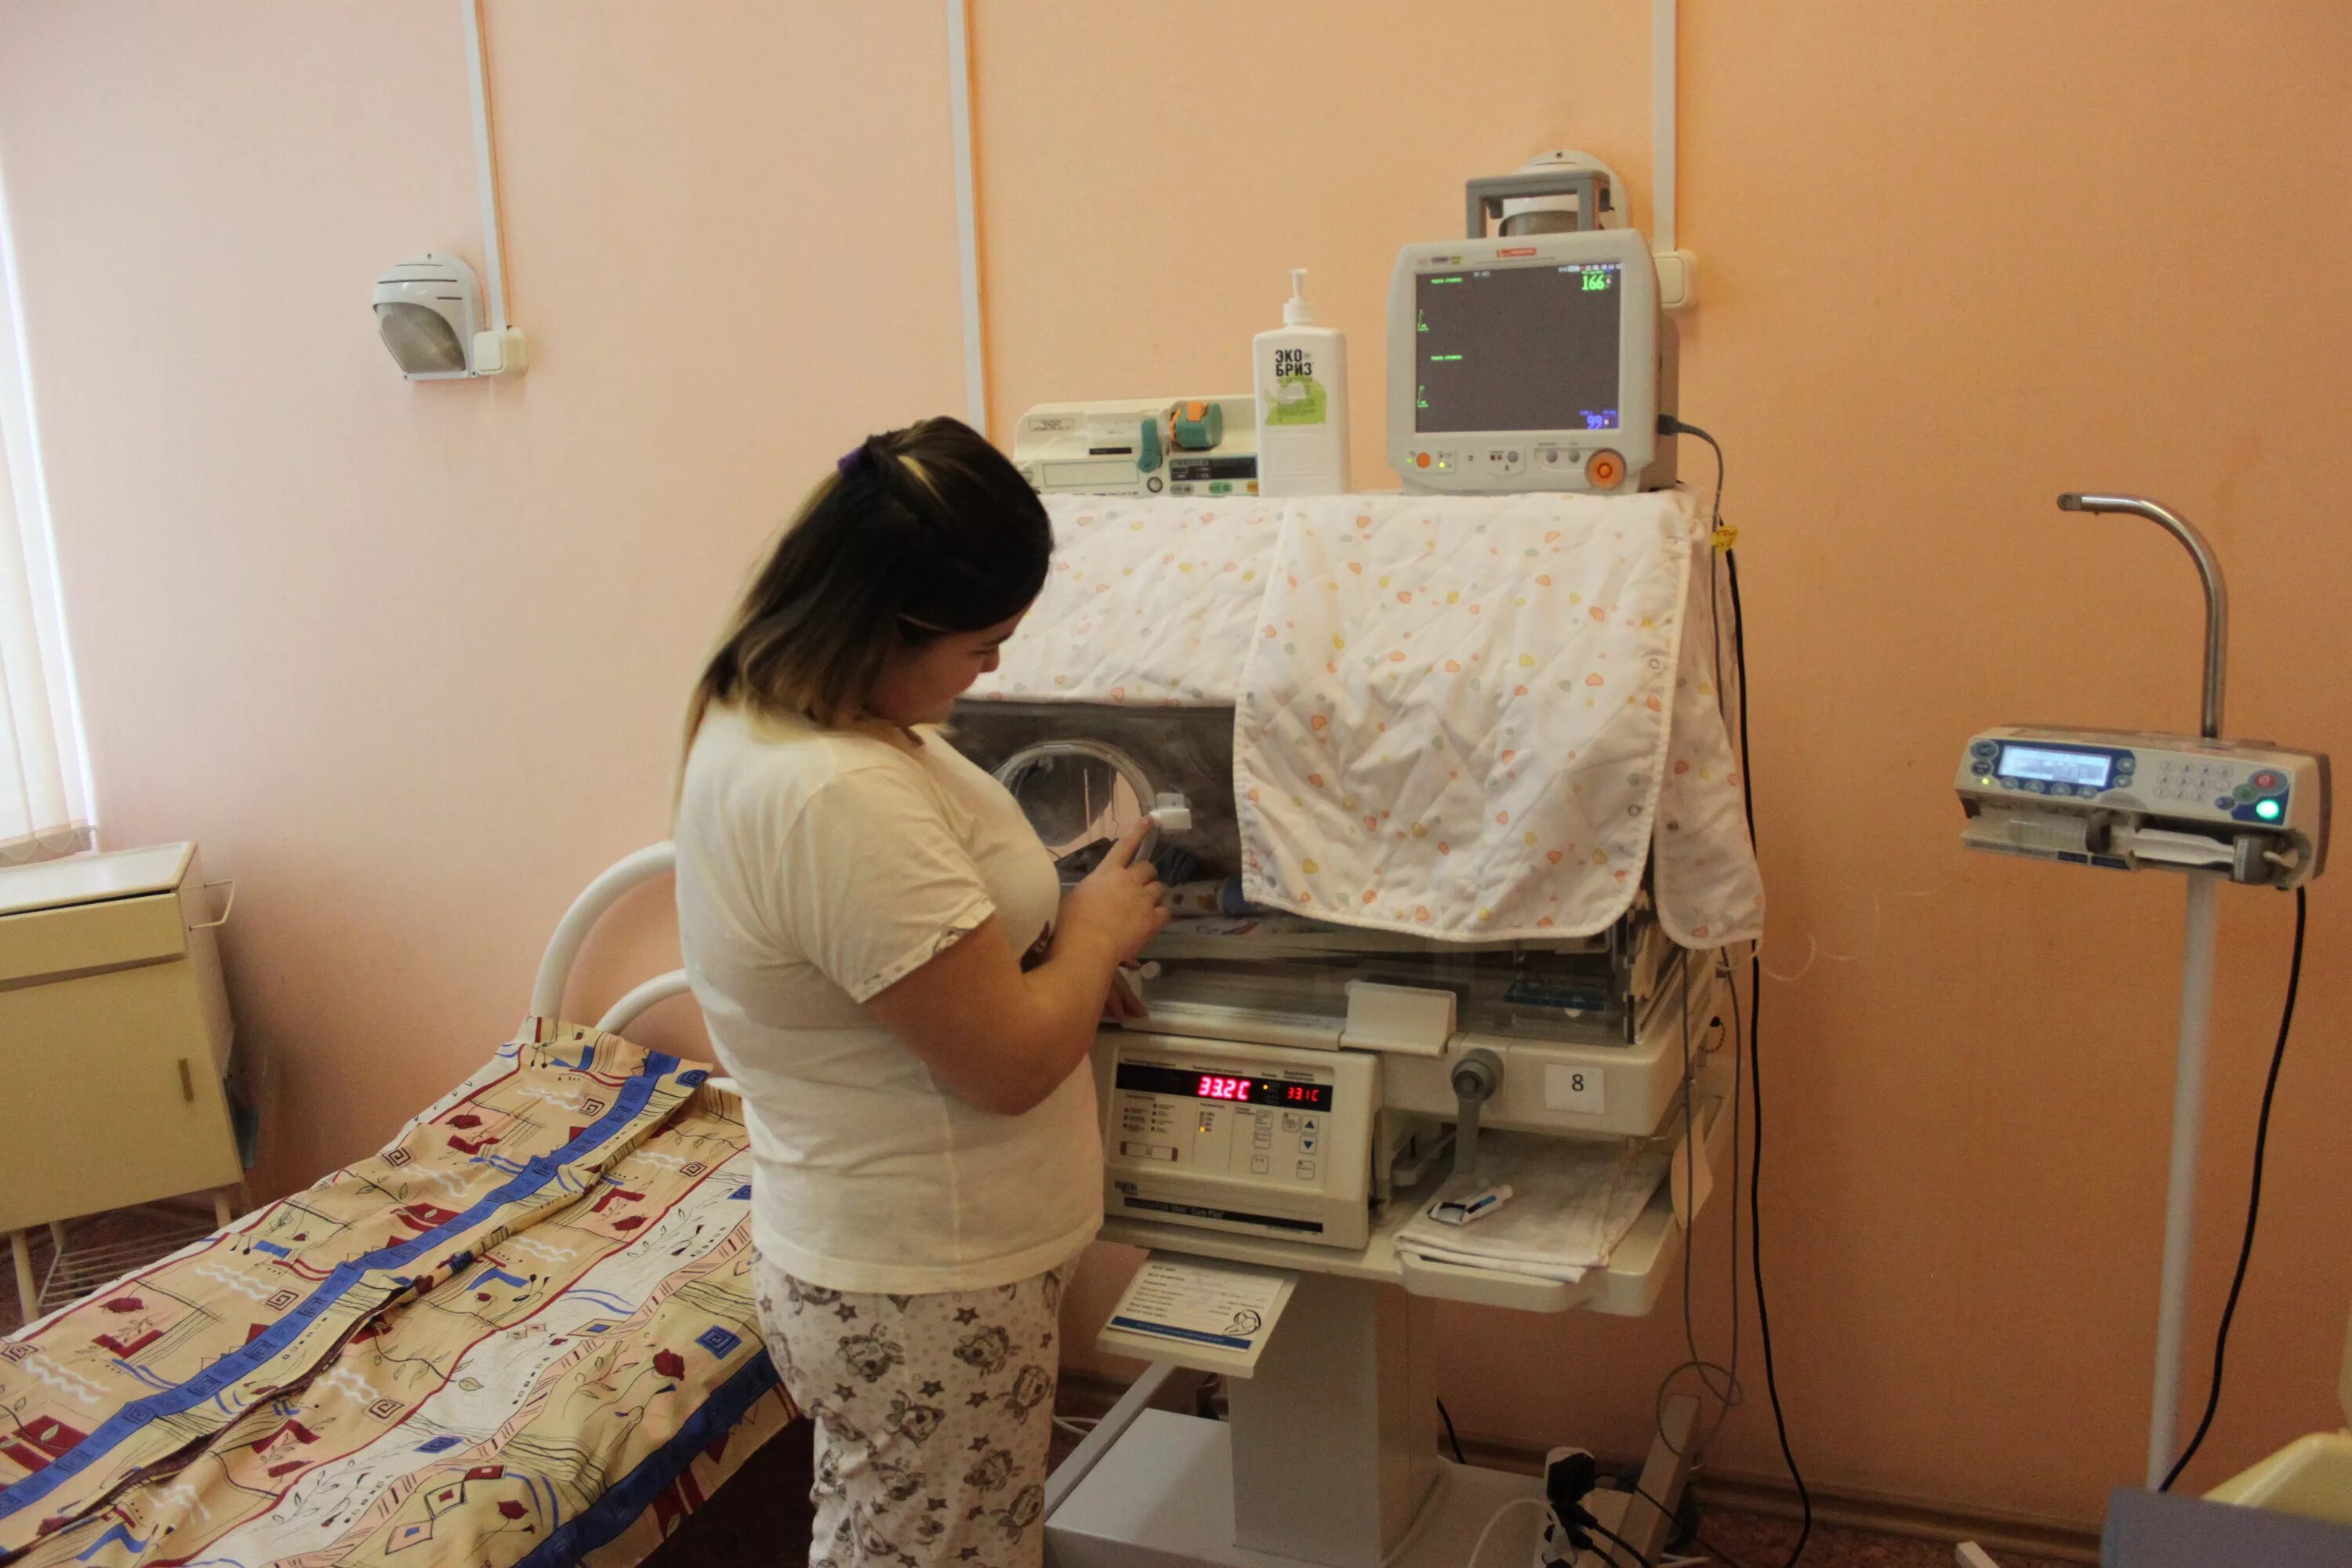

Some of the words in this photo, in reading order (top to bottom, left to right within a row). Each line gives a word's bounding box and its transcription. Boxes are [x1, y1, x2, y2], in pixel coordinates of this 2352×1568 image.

[1581, 274, 1605, 291] 166
[1275, 349, 1302, 363] ЭКО
[1275, 362, 1312, 377] БРИЗ
[1587, 415, 1602, 430] 99
[1571, 1073, 1584, 1092] 8
